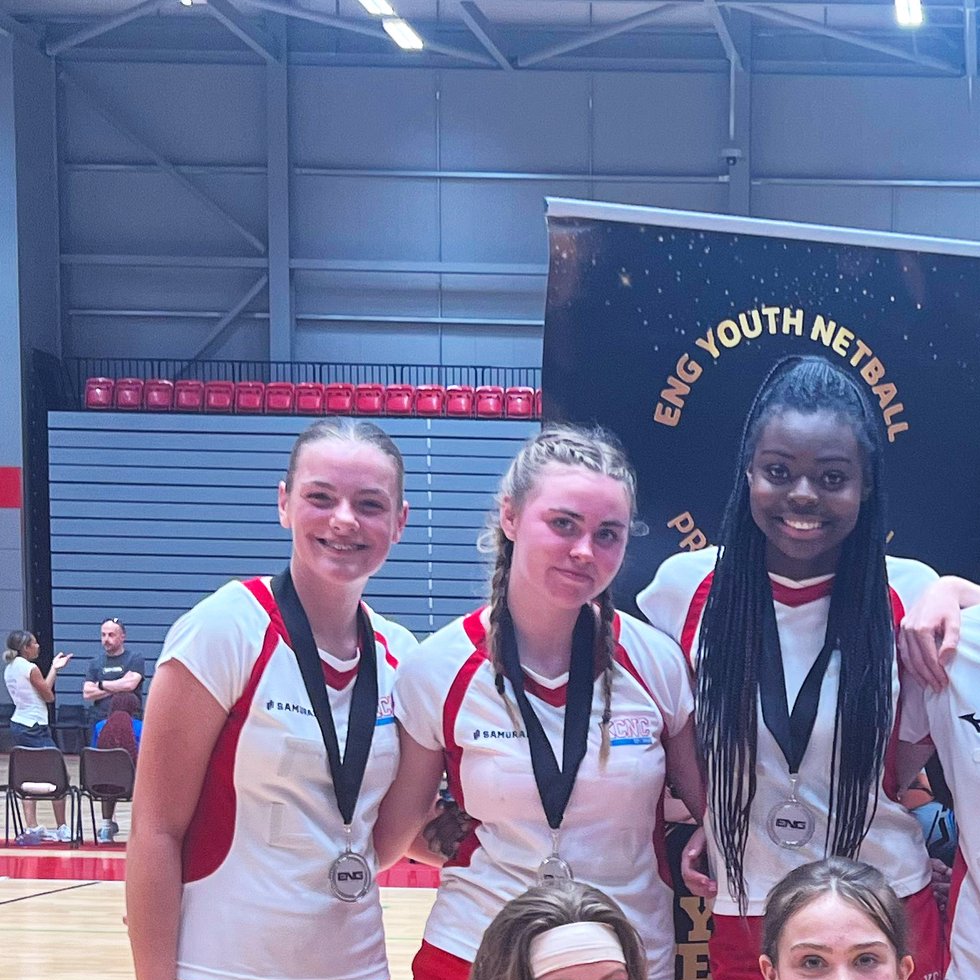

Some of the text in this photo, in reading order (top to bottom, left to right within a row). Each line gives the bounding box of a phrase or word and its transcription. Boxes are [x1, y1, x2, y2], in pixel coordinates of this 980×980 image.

[653, 305, 909, 443] ENG YOUTH NETBALL
[483, 730, 527, 739] SAMURA
[775, 817, 806, 830] ENG
[337, 871, 363, 882] ENG
